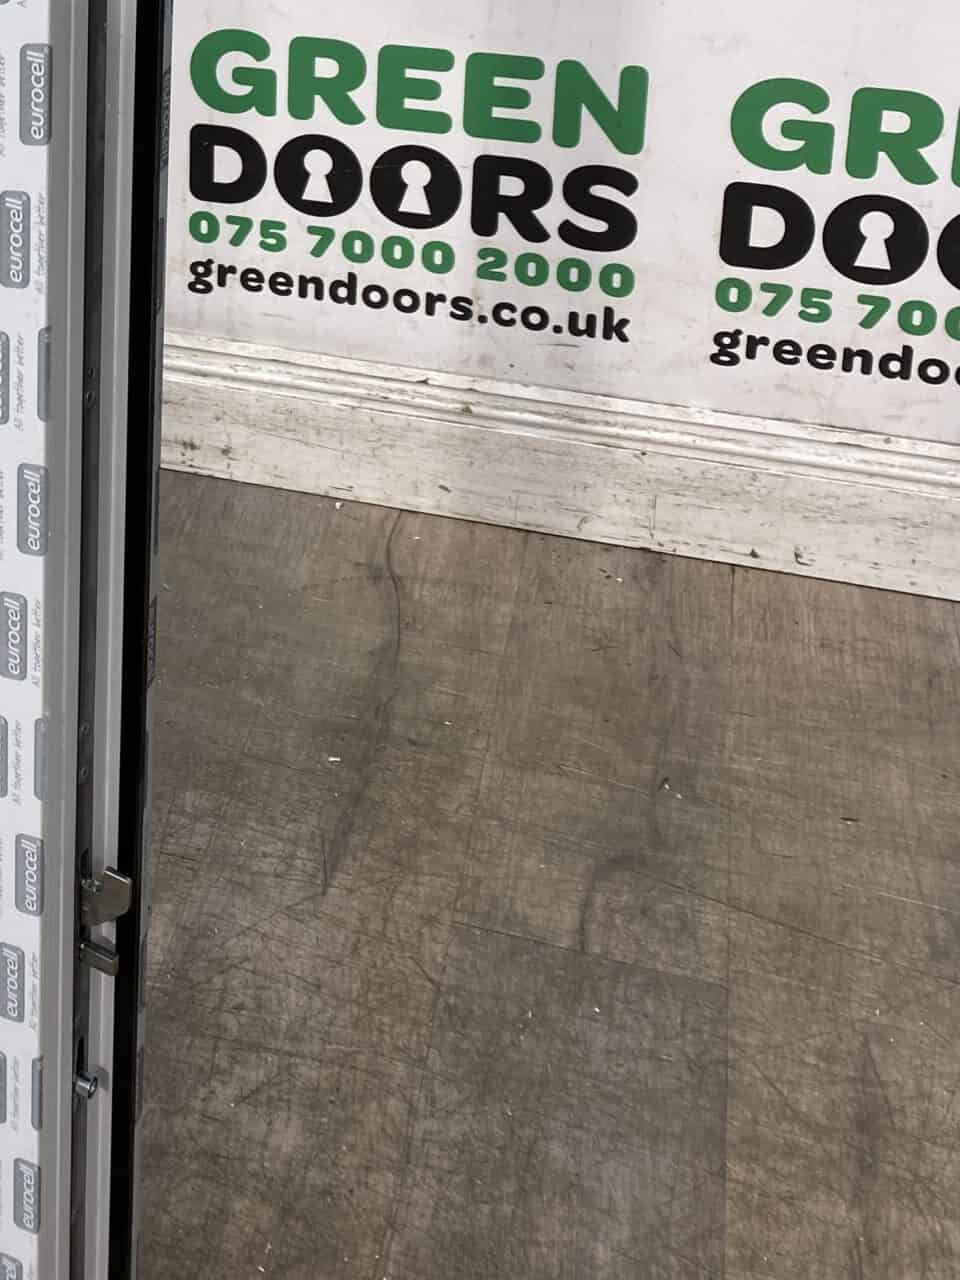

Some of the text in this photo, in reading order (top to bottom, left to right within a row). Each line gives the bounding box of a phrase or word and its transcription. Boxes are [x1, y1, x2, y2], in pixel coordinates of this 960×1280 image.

[26, 48, 46, 140] eurocell
[190, 28, 649, 155] GREEN
[188, 123, 639, 253] DOORS
[5, 196, 24, 284] eurocell
[189, 211, 635, 298] 075 7000 2000
[187, 258, 630, 343] greendoors.co.uk
[715, 277, 833, 324] 075
[23, 469, 41, 551] eurocell
[3, 597, 21, 675] eurocell
[21, 839, 38, 912] eurocell
[2, 947, 19, 1018] eurocell
[20, 1165, 35, 1229] eurocell
